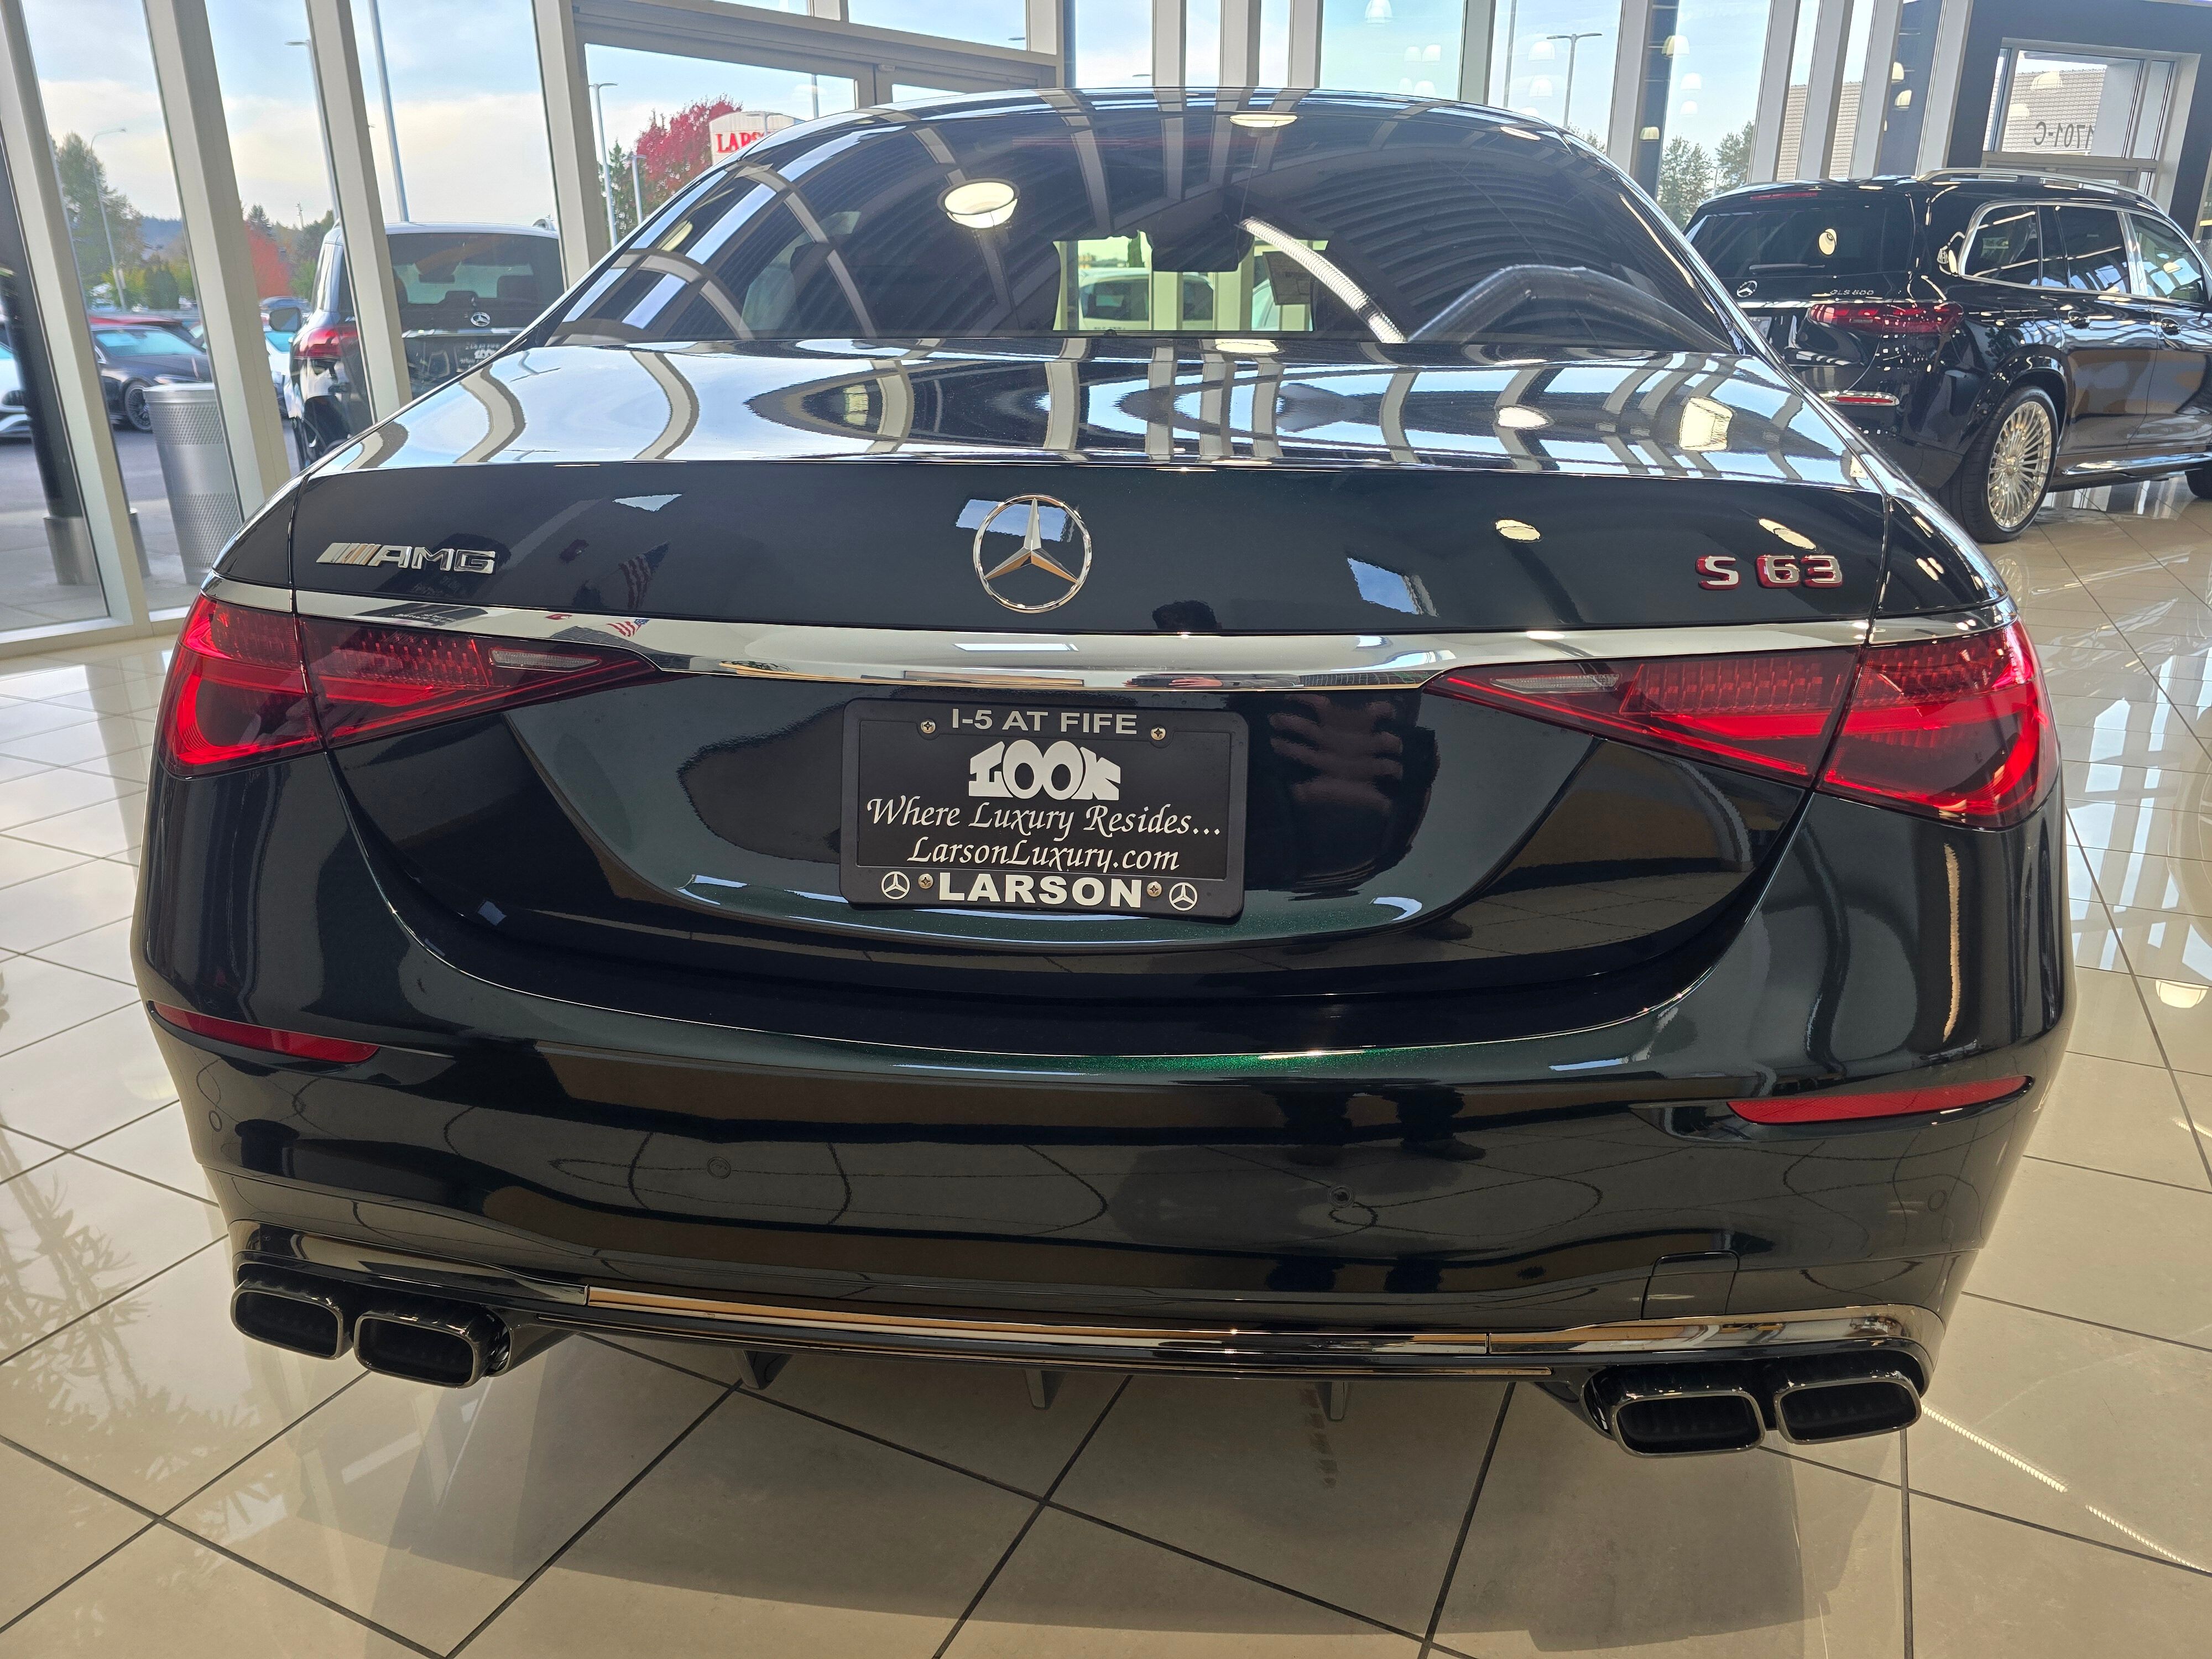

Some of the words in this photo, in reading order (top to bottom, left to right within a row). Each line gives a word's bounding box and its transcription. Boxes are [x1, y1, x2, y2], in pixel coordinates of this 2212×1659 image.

[369, 545, 496, 574] AMG
[1695, 555, 1741, 591] S
[1756, 554, 1843, 589] 63
[952, 708, 993, 730] I-5
[1001, 711, 1048, 732] AT
[1060, 712, 1138, 734] FIFE
[866, 795, 961, 827] Where
[968, 802, 1075, 842] Luxury
[1082, 804, 1221, 838] Resides...
[906, 836, 1180, 874] LarsonLuxury.com
[938, 872, 1142, 908] LARSON
